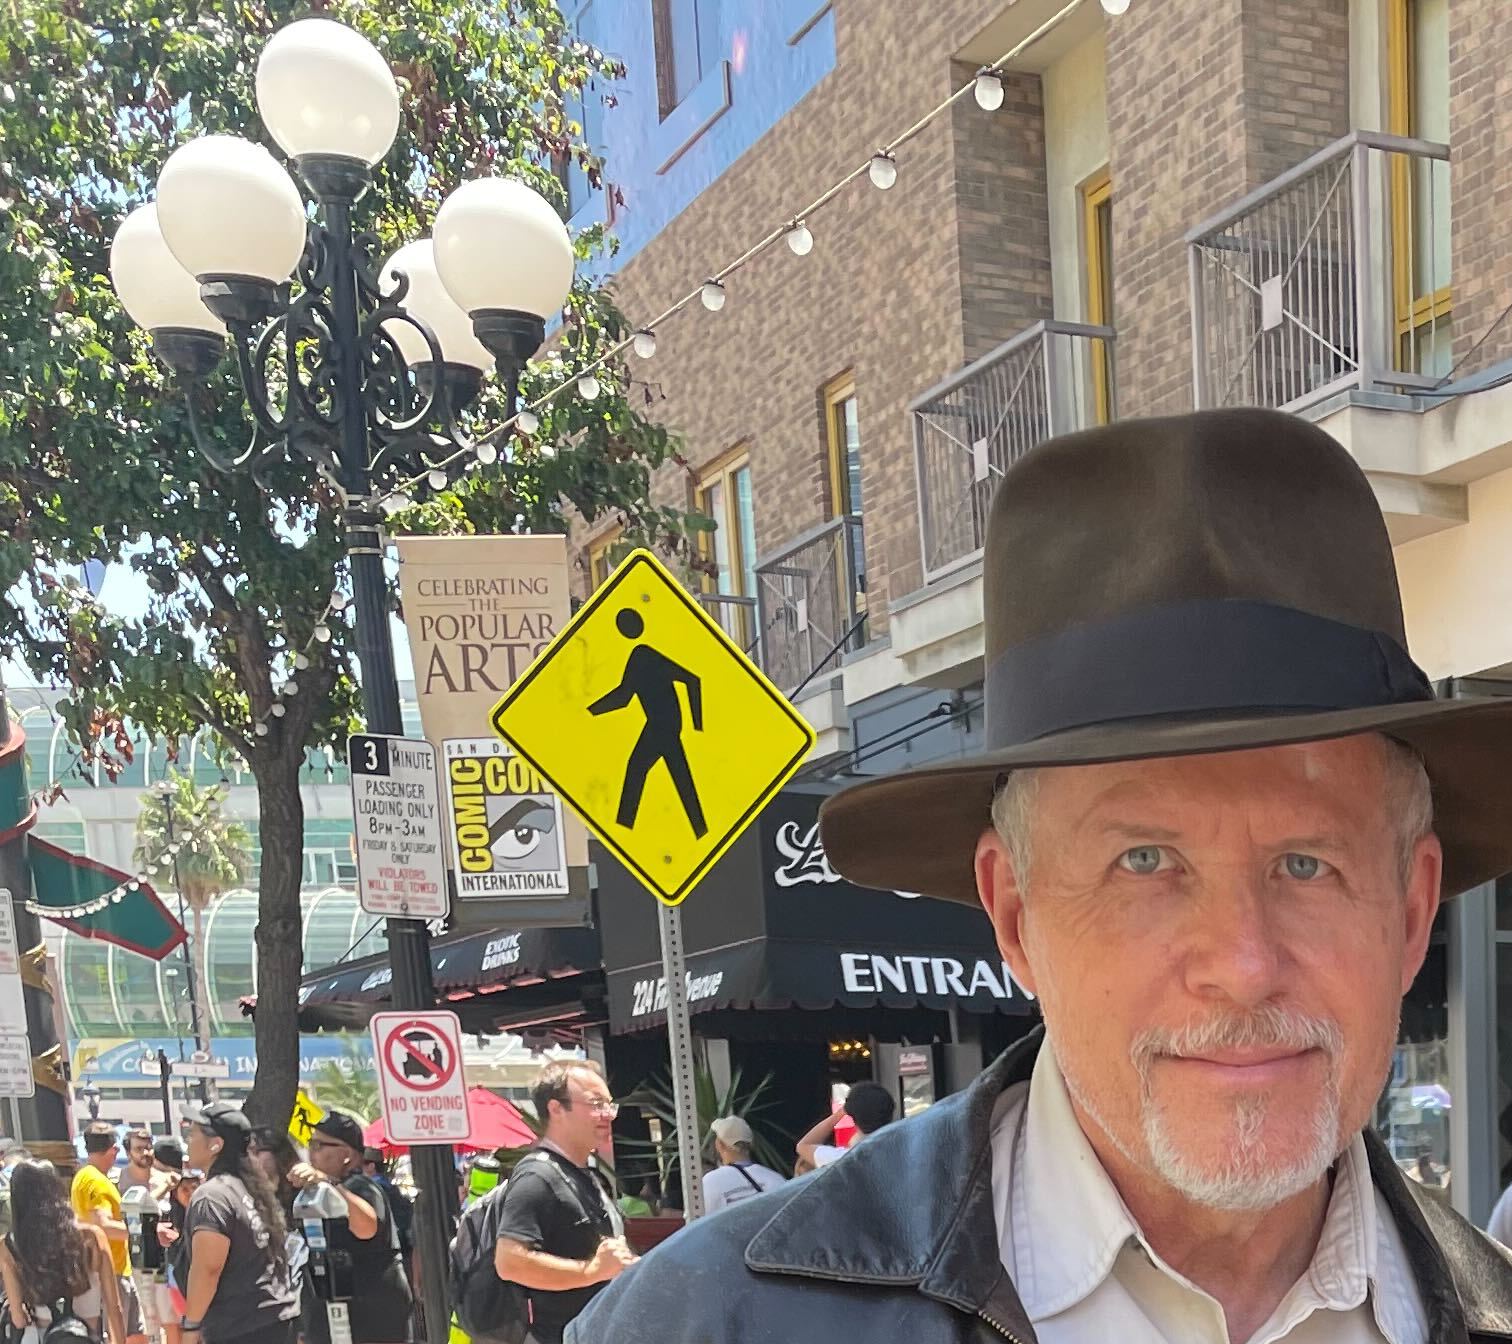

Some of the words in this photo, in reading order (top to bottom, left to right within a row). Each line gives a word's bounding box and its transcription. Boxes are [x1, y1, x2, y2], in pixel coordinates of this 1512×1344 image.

[417, 577, 548, 597] CELEBRATING
[467, 598, 499, 612] THE
[419, 613, 557, 641] POPULAR
[421, 642, 553, 695] ART
[364, 740, 378, 771] 3
[392, 750, 432, 770] MINUTE
[446, 743, 477, 755] SAN
[366, 779, 425, 799] PASSENGER
[359, 799, 402, 817] LOADING
[407, 802, 434, 819] ONLY
[451, 758, 493, 872] COMIC
[363, 839, 387, 851] FRIDAY
[400, 842, 436, 854] SATURDAY
[391, 853, 410, 865] ONLY
[377, 867, 426, 881] VIOLATORS
[462, 874, 563, 892] INTERNATIONAL
[368, 880, 387, 891] WILL
[393, 881, 405, 892] BE
[410, 882, 438, 894] TOWED
[481, 946, 521, 971] DRINKS
[632, 979, 655, 1016] 224
[390, 1096, 408, 1112] NO
[411, 1095, 463, 1111] VENDING
[414, 1114, 444, 1130] ZONE
